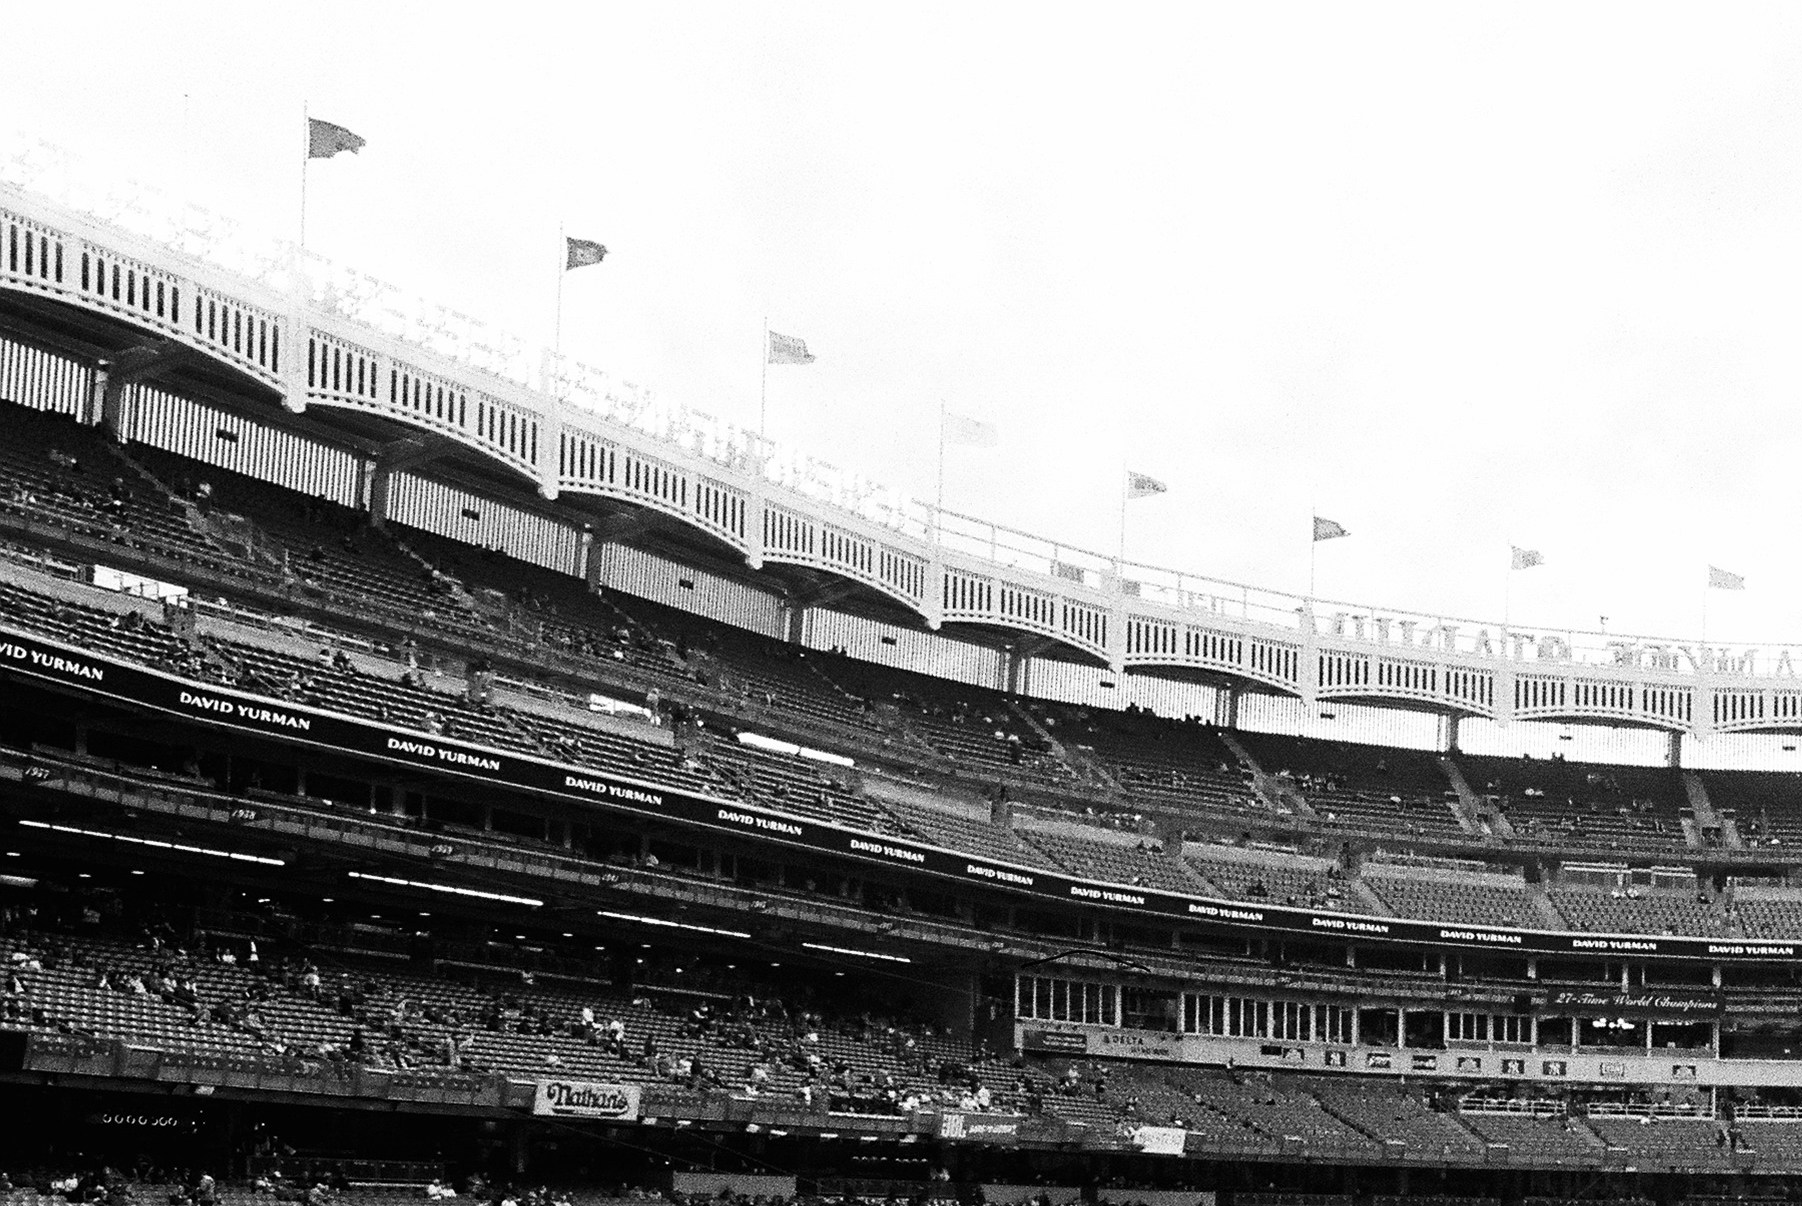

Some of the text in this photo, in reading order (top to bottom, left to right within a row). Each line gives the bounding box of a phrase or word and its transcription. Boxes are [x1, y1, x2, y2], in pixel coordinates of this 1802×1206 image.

[31, 650, 104, 681] YURMAN
[180, 692, 311, 731] DAVID YURMAN
[387, 738, 500, 771] DAVID YURMAN
[565, 776, 663, 805] DAVID YURMAN
[718, 809, 803, 835] DAVID YURMAN
[850, 839, 926, 862] DAVID YURMAN
[967, 865, 1034, 886] DAVID YURMAN
[1071, 886, 1145, 905] DAVID YURMAN
[1189, 904, 1264, 921] DAVID YURMAN
[1313, 918, 1389, 934] DAVID YURMAN
[1441, 930, 1522, 944] DAVID YURMAN
[1573, 940, 1657, 951] DAVID YURMAN
[1708, 945, 1794, 955] DAVID YURMAN
[1613, 994, 1654, 1007] World
[1655, 996, 1718, 1012] Champions
[546, 1082, 630, 1111] Nathan's
